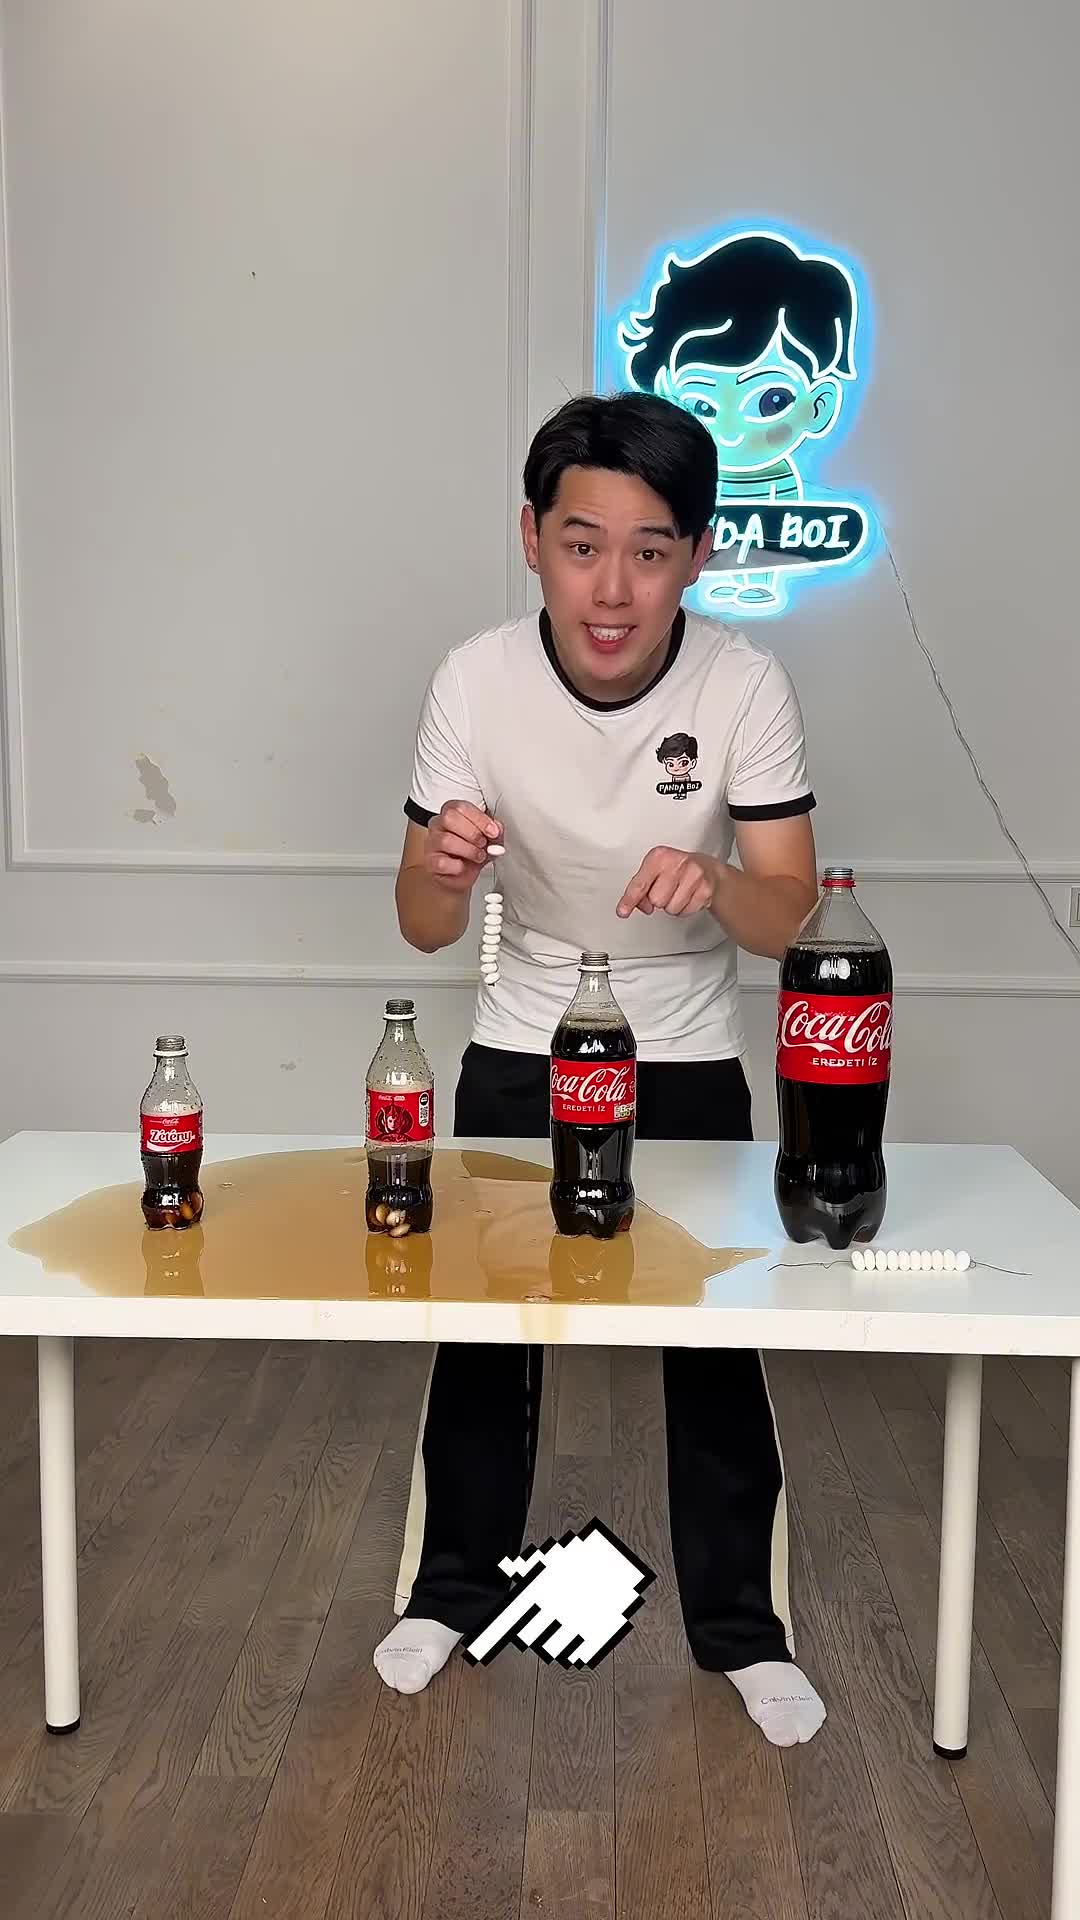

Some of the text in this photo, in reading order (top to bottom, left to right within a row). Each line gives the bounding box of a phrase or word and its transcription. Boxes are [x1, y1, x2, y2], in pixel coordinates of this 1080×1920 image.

[712, 513, 850, 564] DA BOI
[659, 782, 700, 793] PANDA BOI
[812, 1057, 865, 1067] EREDETI
[562, 1103, 595, 1112] EREDETI
